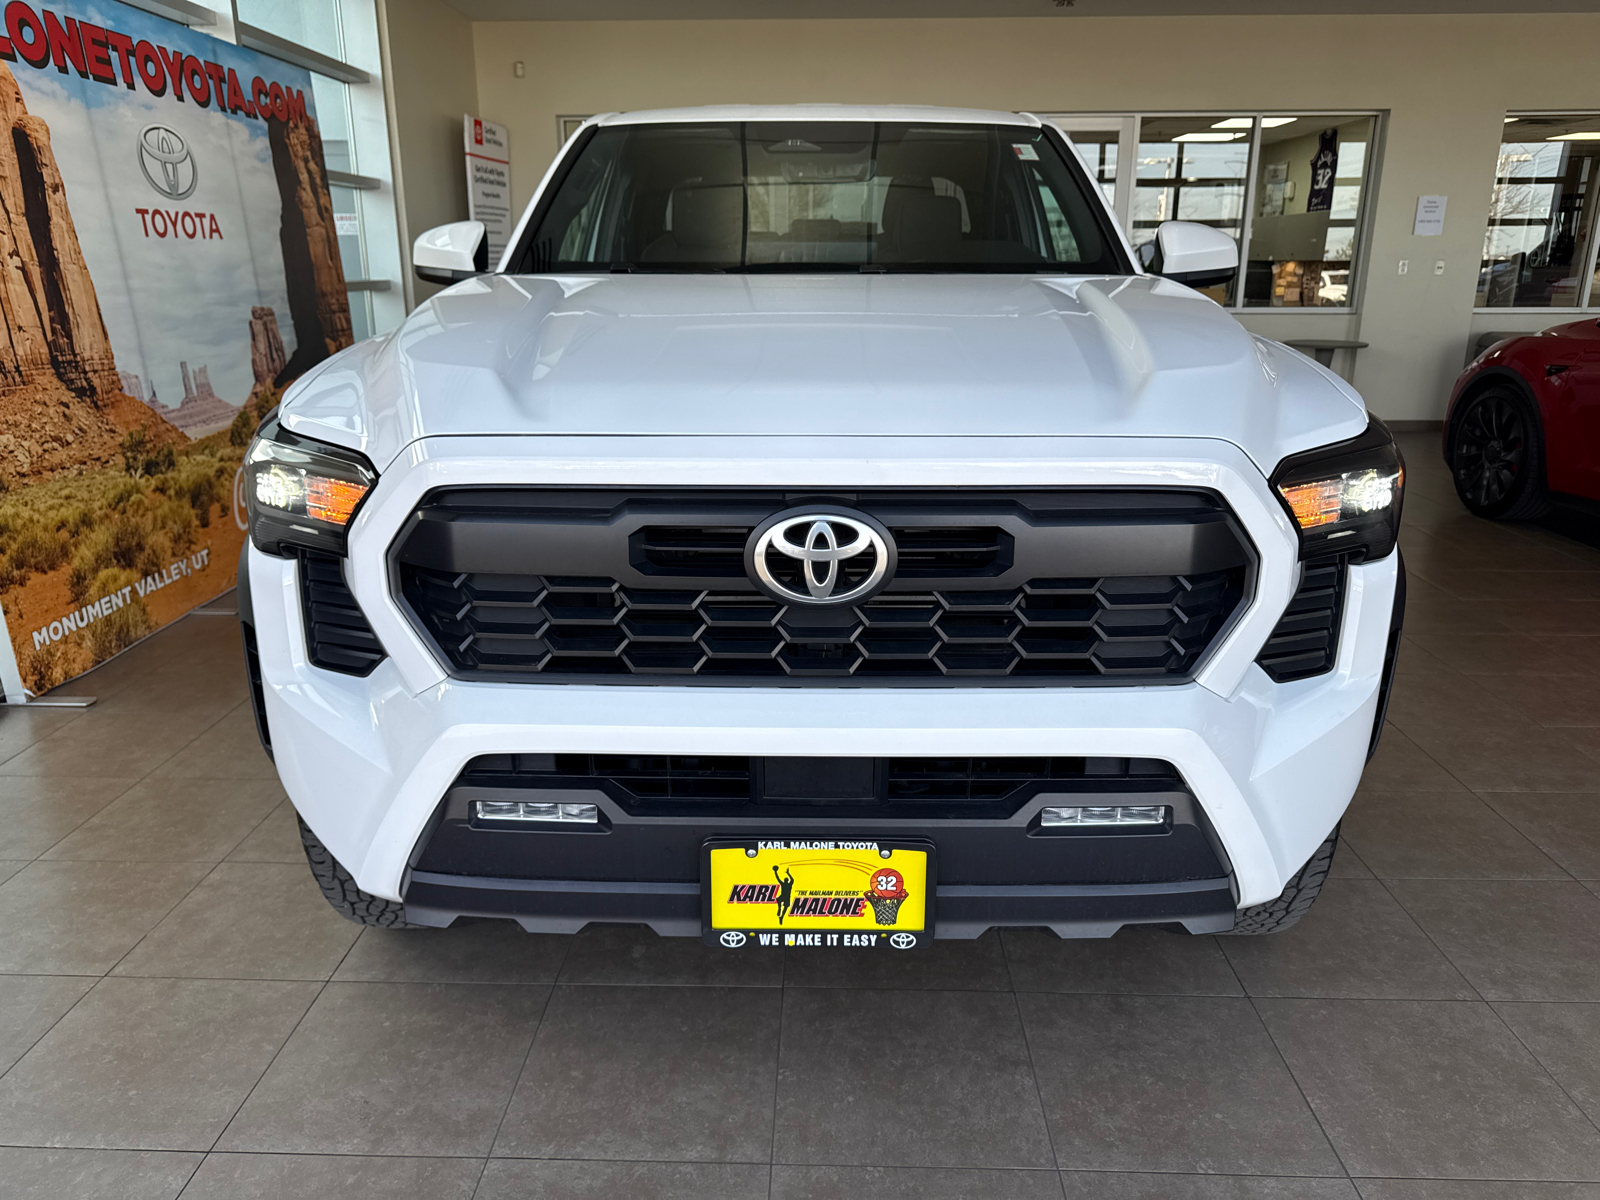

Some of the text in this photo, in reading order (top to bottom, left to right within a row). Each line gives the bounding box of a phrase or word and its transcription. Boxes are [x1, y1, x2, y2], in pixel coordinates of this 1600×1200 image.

[1313, 168, 1332, 190] 32
[135, 208, 223, 240] TOYOTA
[31, 548, 209, 651] MONUMENT VALLEY, UT
[758, 841, 879, 850] KARL MALONE TOYOTA
[876, 875, 897, 891] 32
[727, 884, 780, 904] KARL
[788, 897, 868, 917] MALONE
[759, 933, 877, 947] WE MAKE IT EASY
